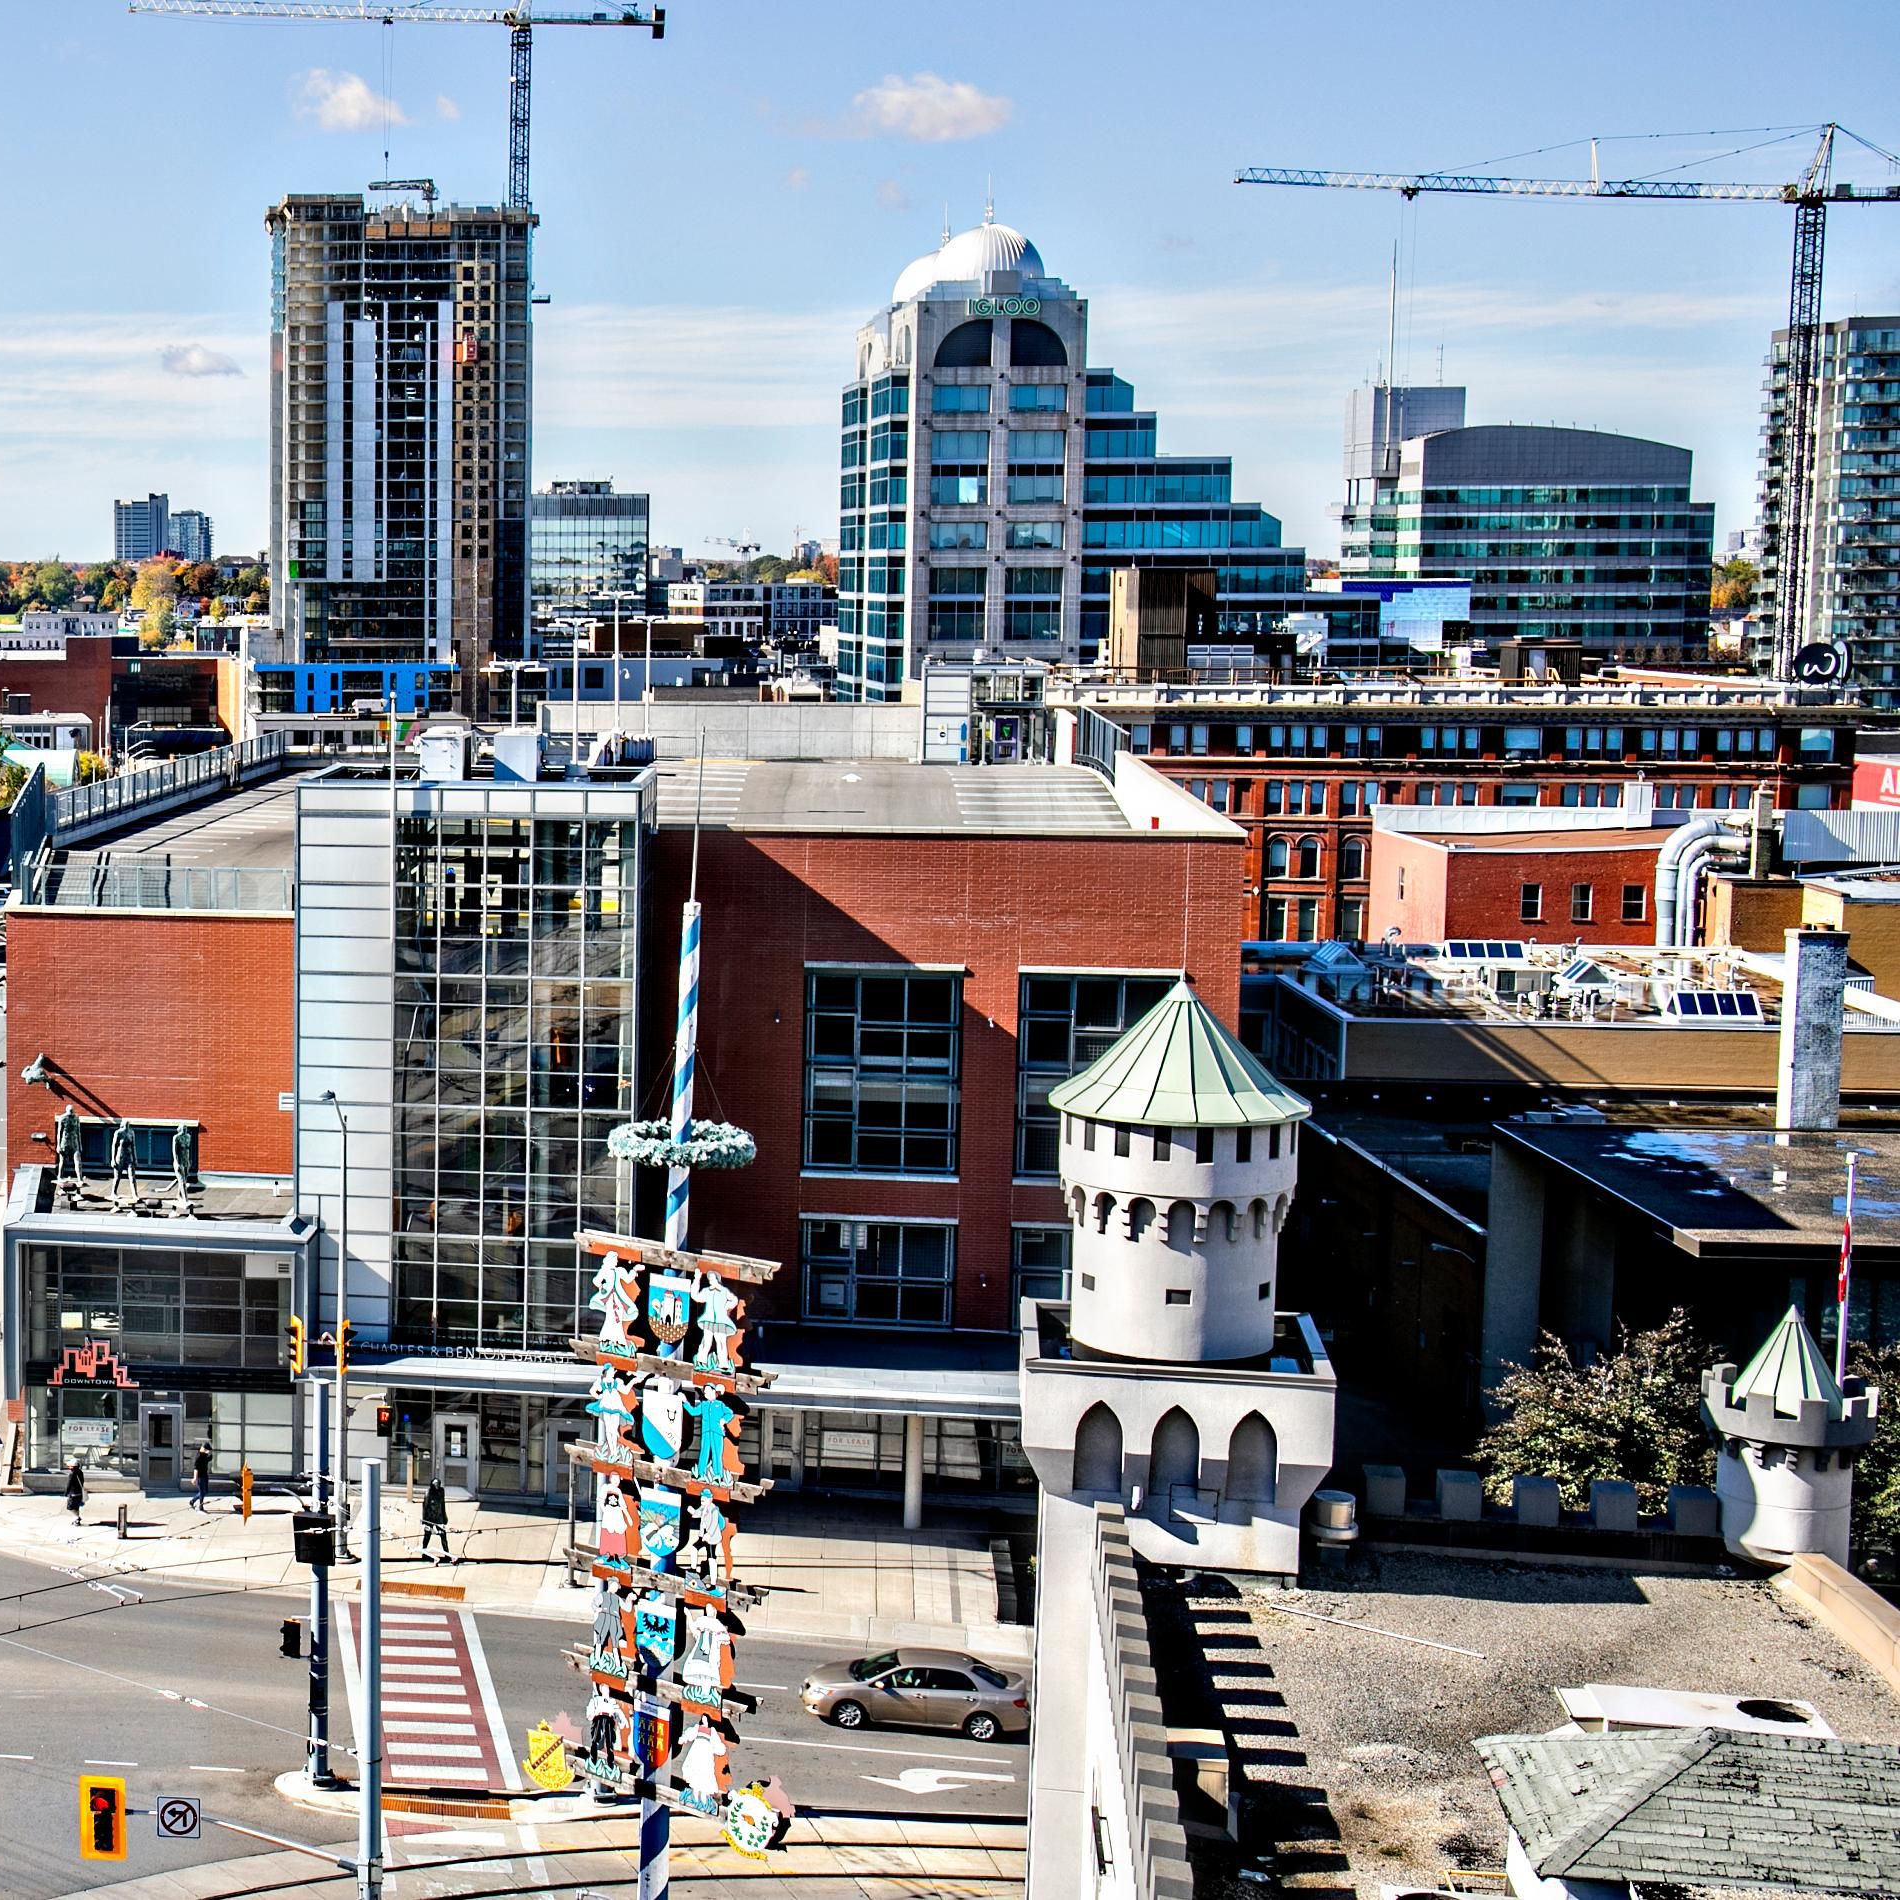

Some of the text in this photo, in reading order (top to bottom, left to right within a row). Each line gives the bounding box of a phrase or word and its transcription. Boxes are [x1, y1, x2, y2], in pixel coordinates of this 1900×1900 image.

[966, 297, 1041, 316] IGLOO
[1880, 767, 1900, 795] A
[360, 1341, 425, 1357] CHARLES
[430, 1346, 440, 1357] &
[445, 1346, 506, 1361] BENTON
